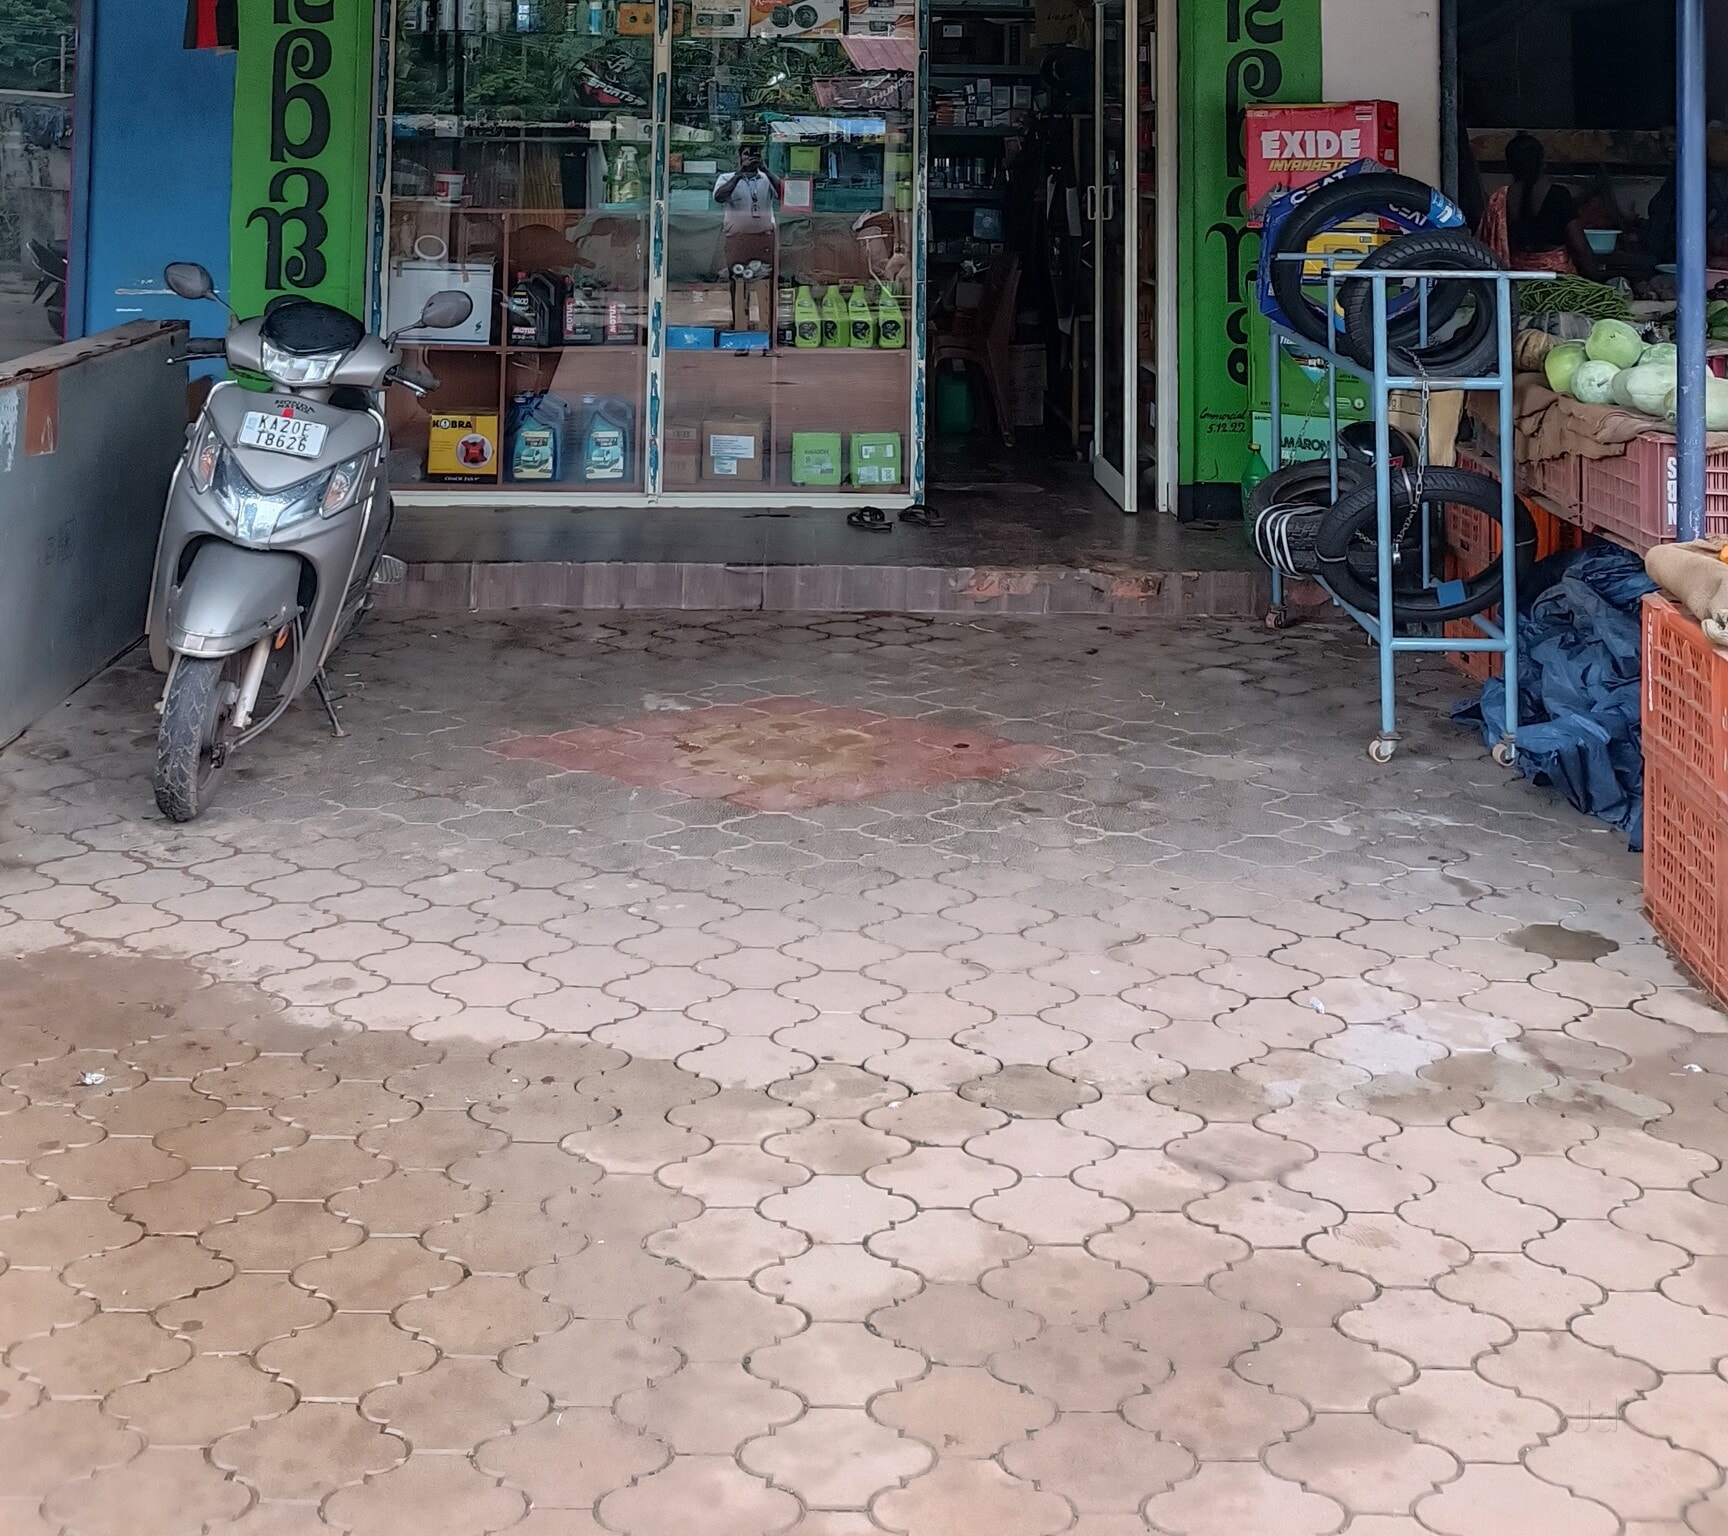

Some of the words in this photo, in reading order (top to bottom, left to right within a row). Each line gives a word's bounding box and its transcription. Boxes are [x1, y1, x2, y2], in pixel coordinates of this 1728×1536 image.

[587, 76, 637, 103] SPORTS
[1260, 128, 1361, 159] EXIDE
[1268, 159, 1353, 172] INVAMASTE
[1290, 169, 1347, 205] CEAT
[258, 415, 312, 437] KA20E
[432, 418, 473, 429] KOBRA
[1280, 436, 1331, 452] MARON
